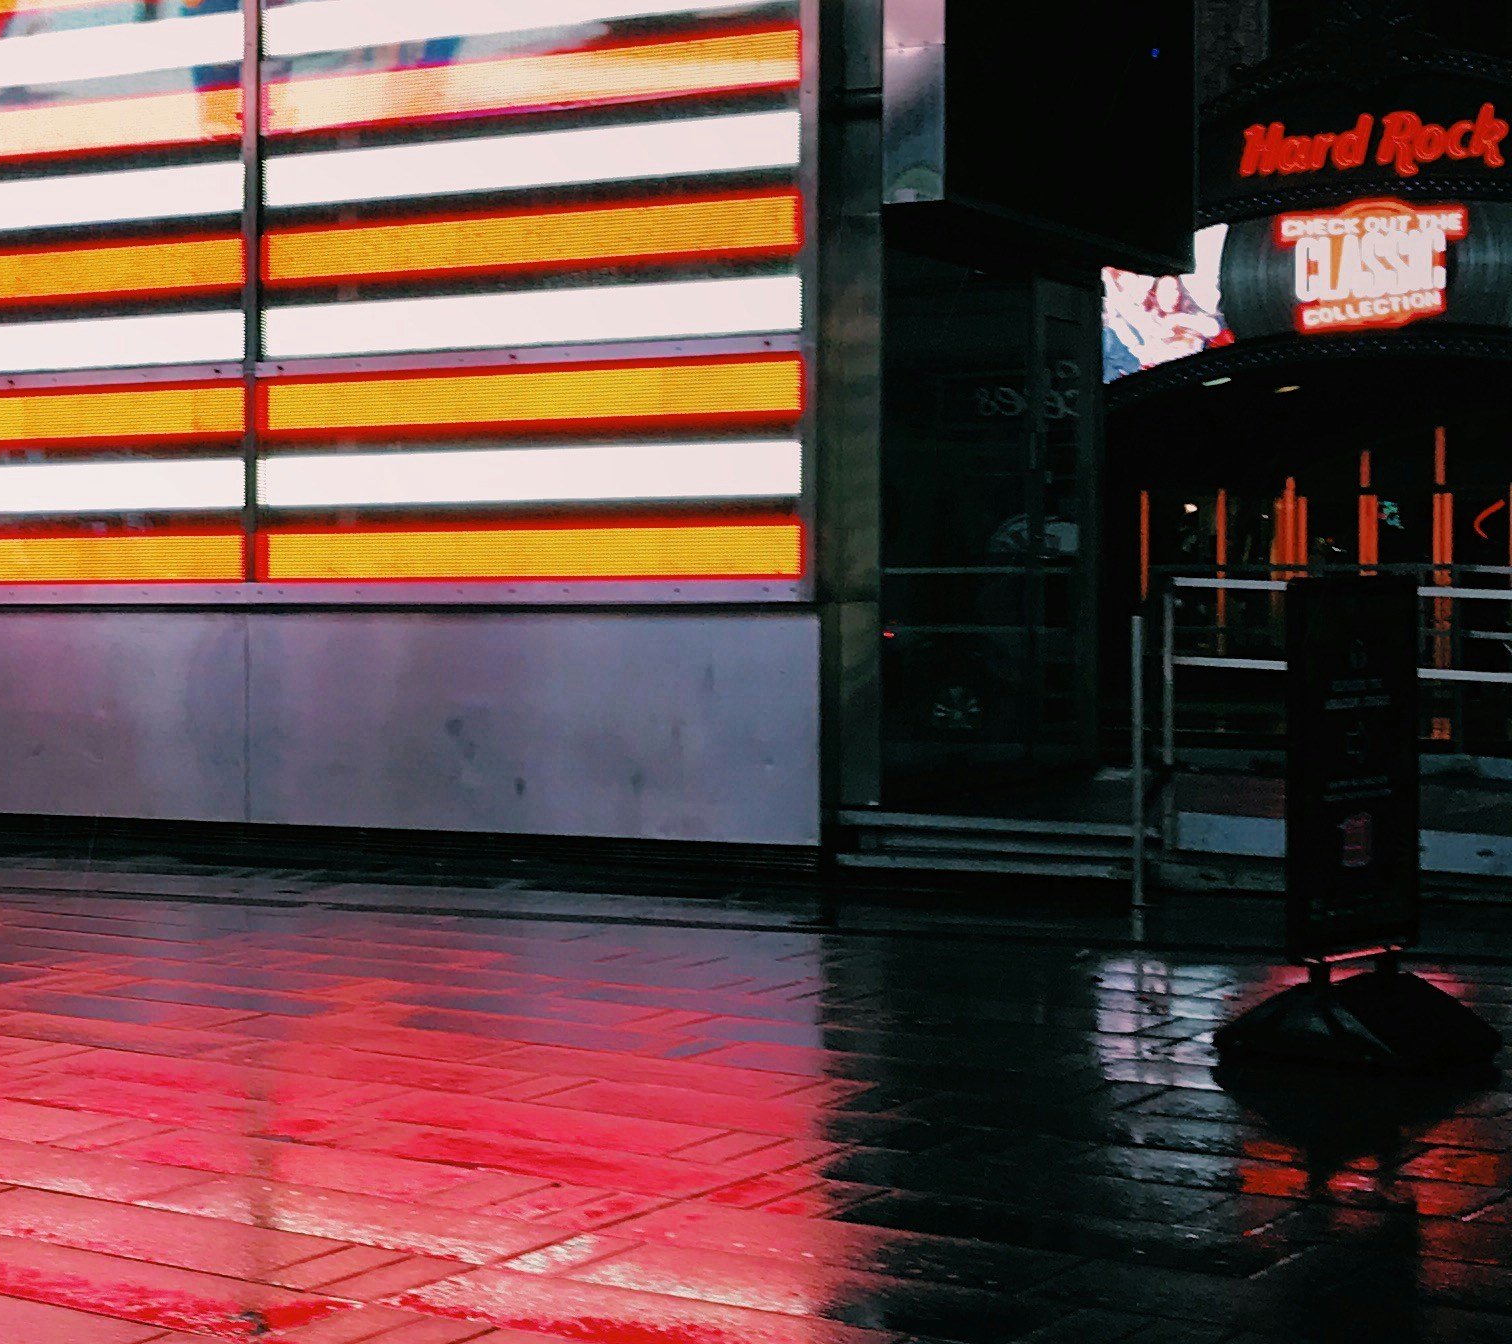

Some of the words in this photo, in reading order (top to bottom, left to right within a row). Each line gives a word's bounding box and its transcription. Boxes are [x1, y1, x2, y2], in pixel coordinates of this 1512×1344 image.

[1238, 112, 1375, 179] Hard
[1375, 101, 1510, 178] Rock
[1281, 216, 1360, 237] CHECK
[1364, 215, 1412, 233] OUT
[1417, 212, 1463, 232] THE
[1295, 229, 1447, 302] CLASSIC
[1303, 291, 1442, 327] COLLECTION
